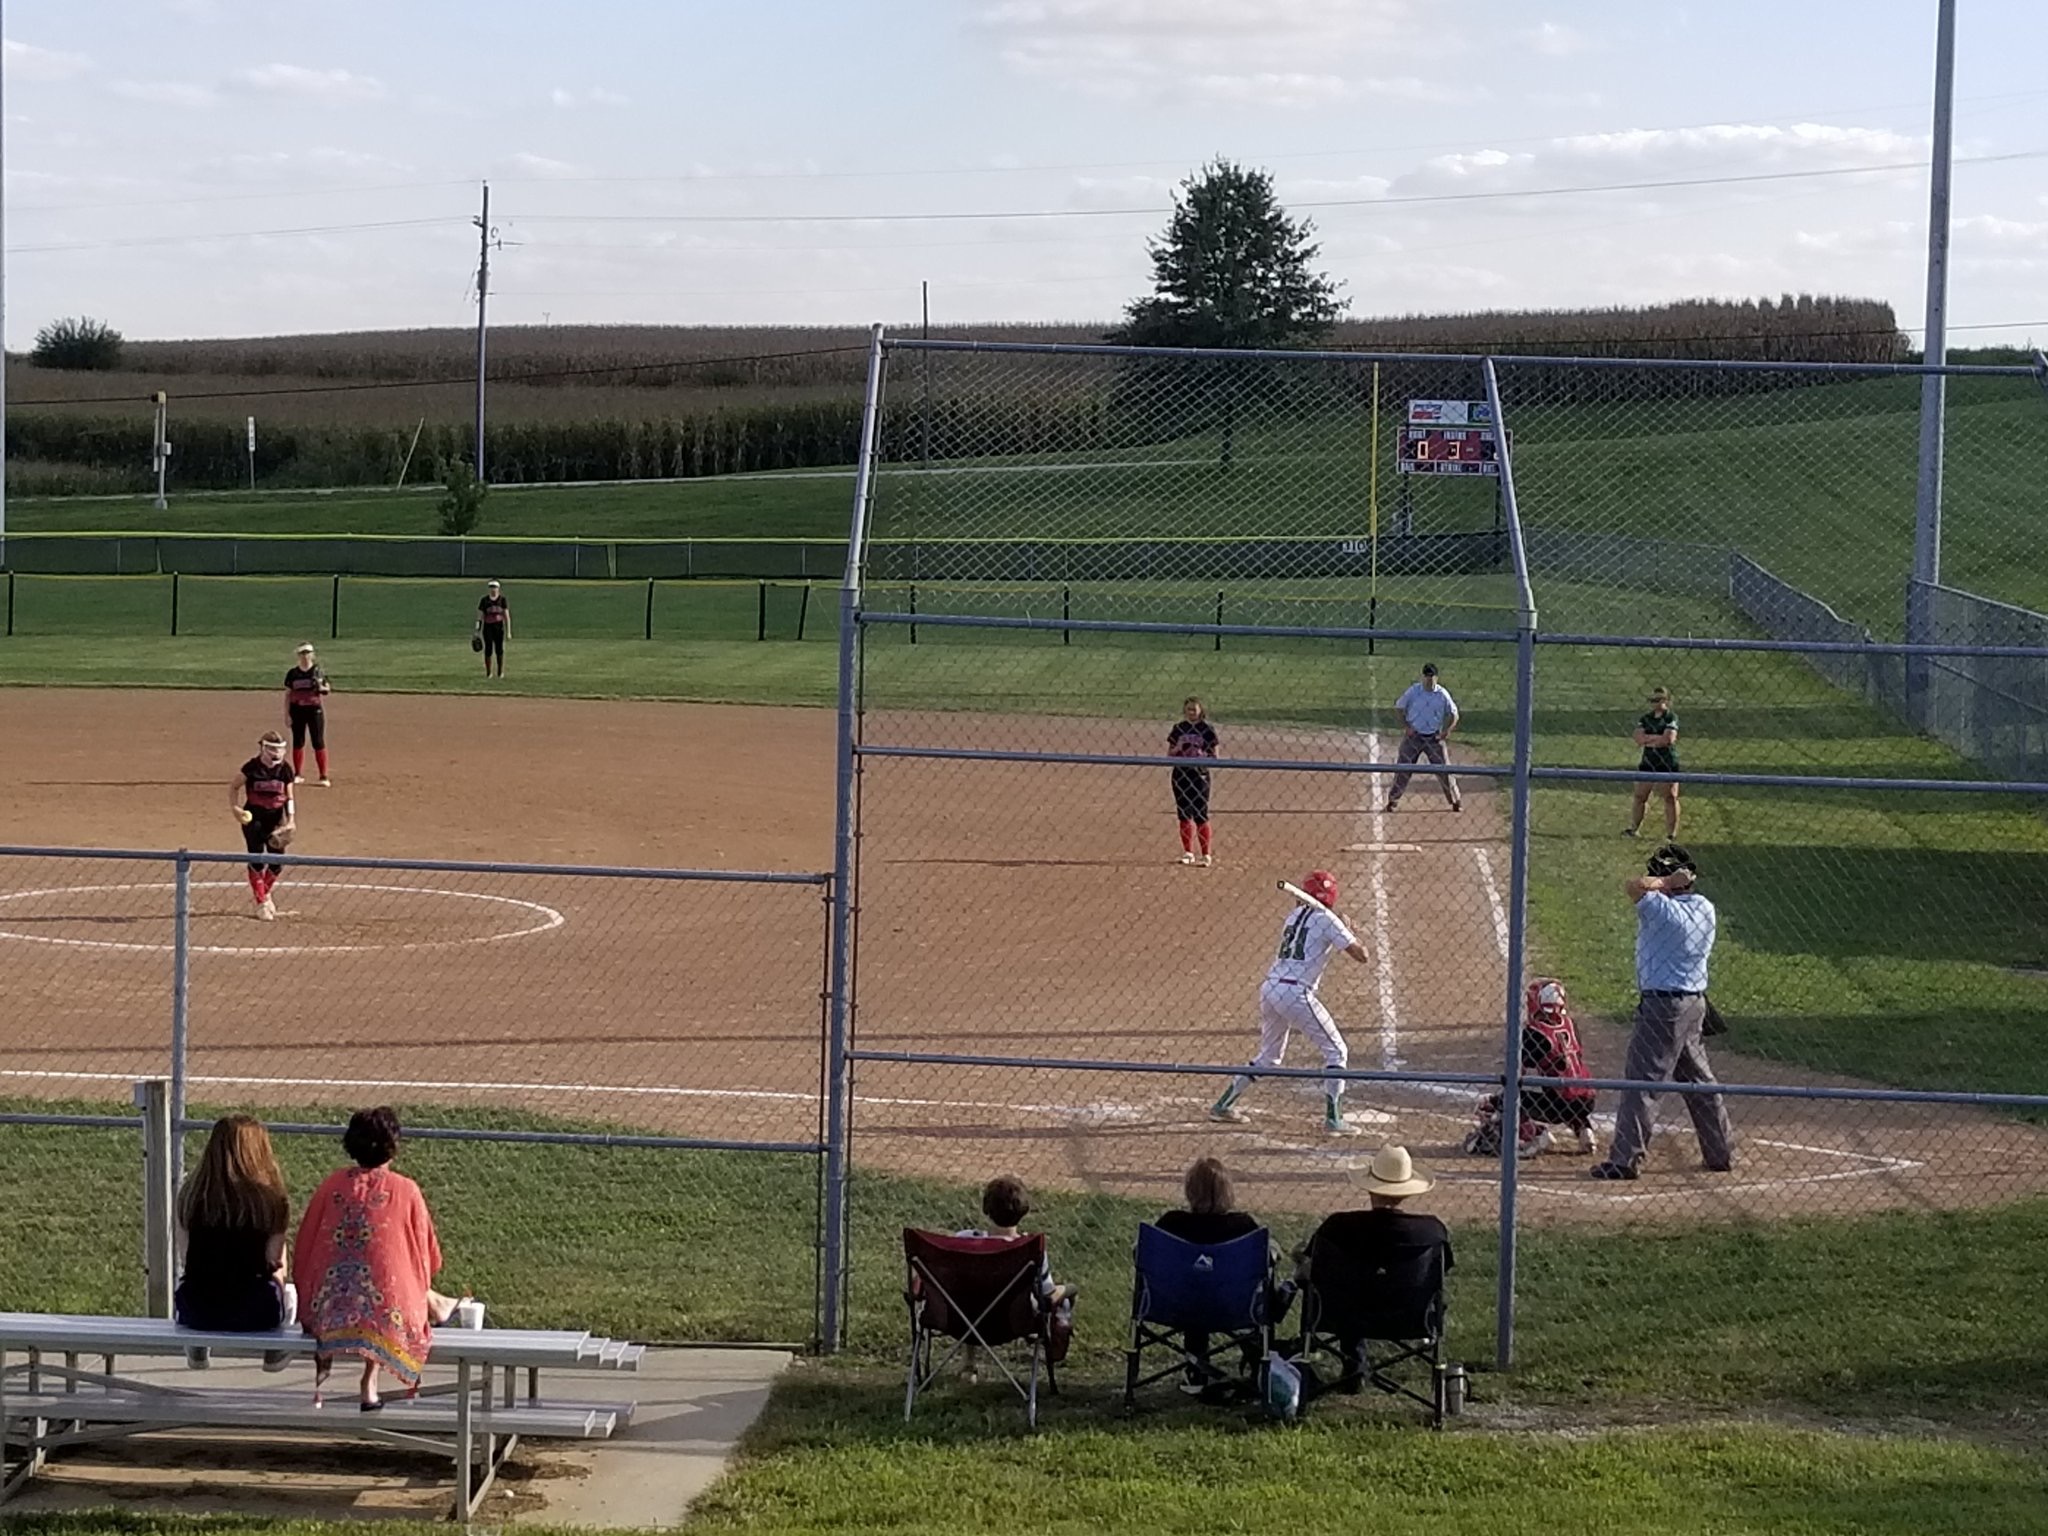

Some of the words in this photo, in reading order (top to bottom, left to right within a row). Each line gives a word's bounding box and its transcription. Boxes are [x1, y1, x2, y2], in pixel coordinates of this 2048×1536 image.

[1418, 441, 1429, 460] 0
[1448, 441, 1461, 460] 3
[1278, 925, 1310, 961] 21
